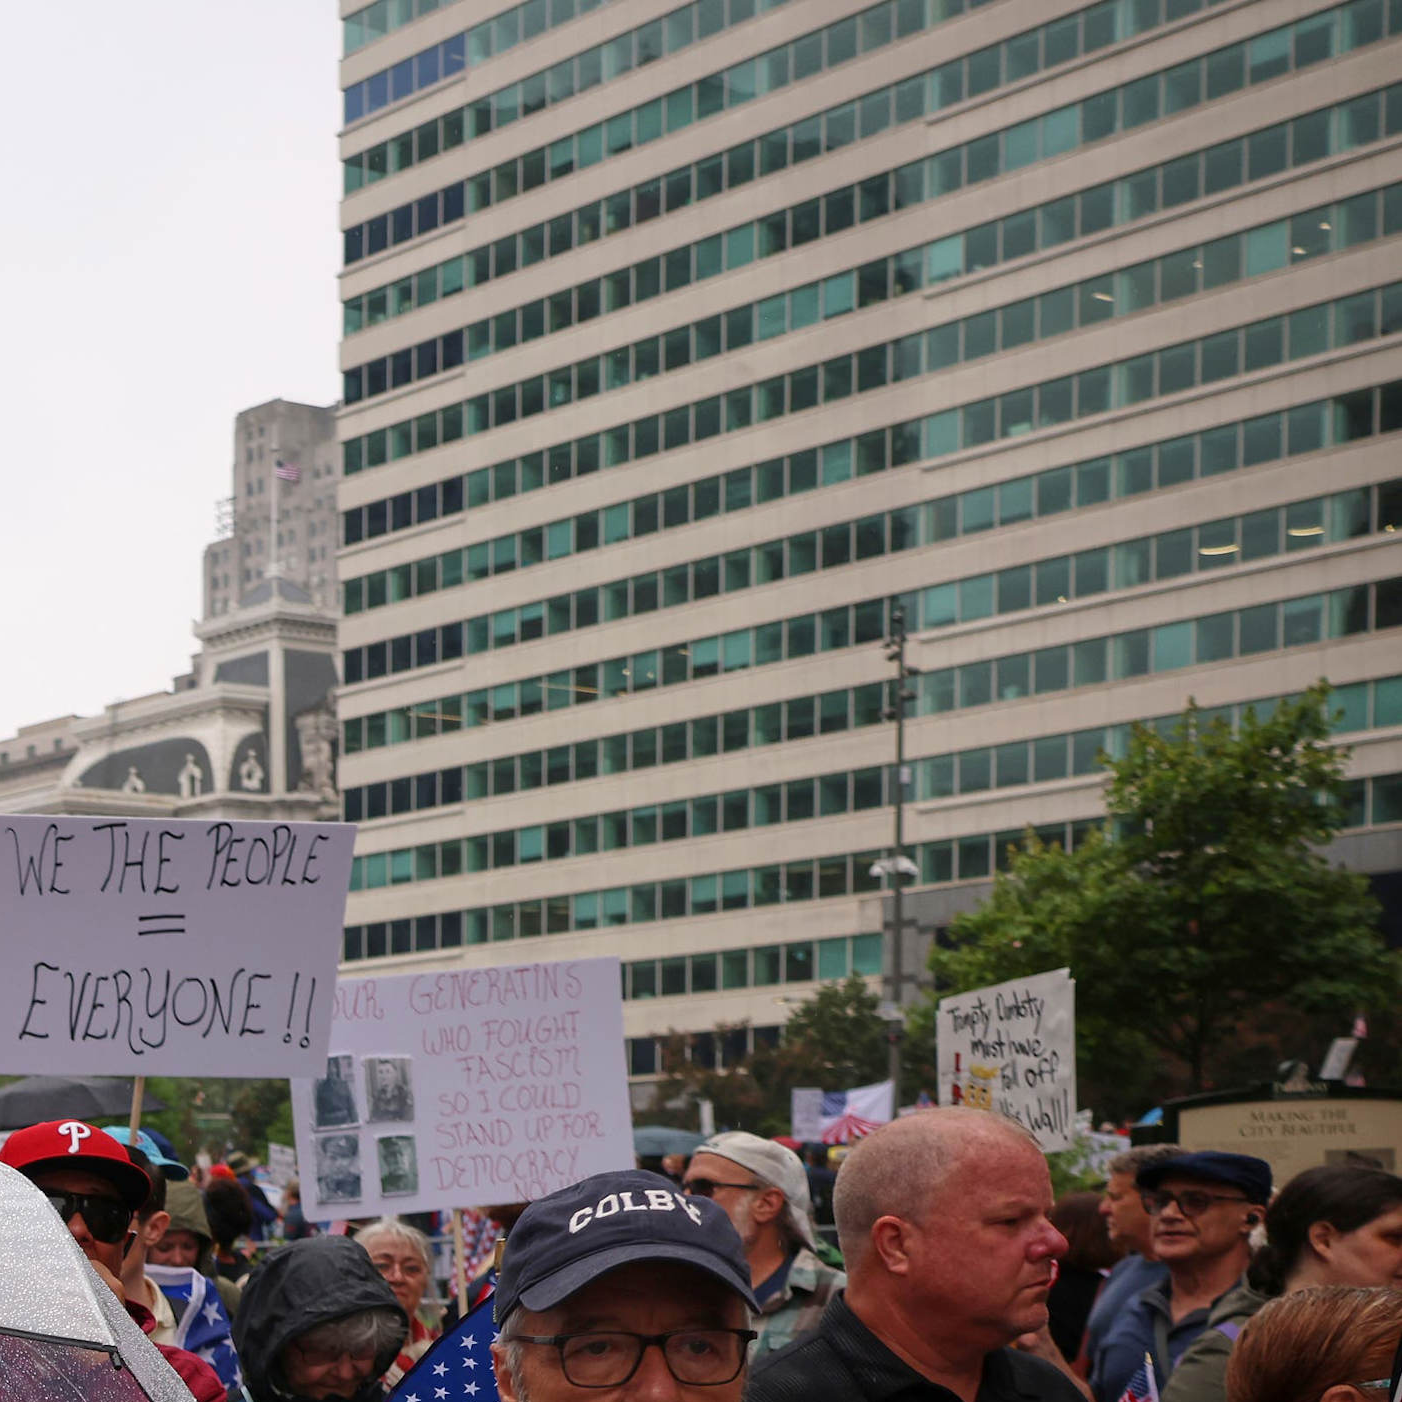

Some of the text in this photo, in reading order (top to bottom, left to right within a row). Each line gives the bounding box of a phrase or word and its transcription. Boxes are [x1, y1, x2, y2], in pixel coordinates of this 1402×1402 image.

[5, 821, 330, 895] WE THE PEOPLE
[422, 1010, 582, 1057] WHO FOUGHT
[437, 1082, 582, 1118] SO I COULD
[1249, 1107, 1347, 1124] MAKING THE
[435, 1121, 514, 1151] STAND
[523, 1117, 557, 1143] UP
[1239, 1126, 1275, 1138] CITY
[429, 1145, 581, 1192] DEMOCRACY
[568, 1189, 702, 1234] COLBY
